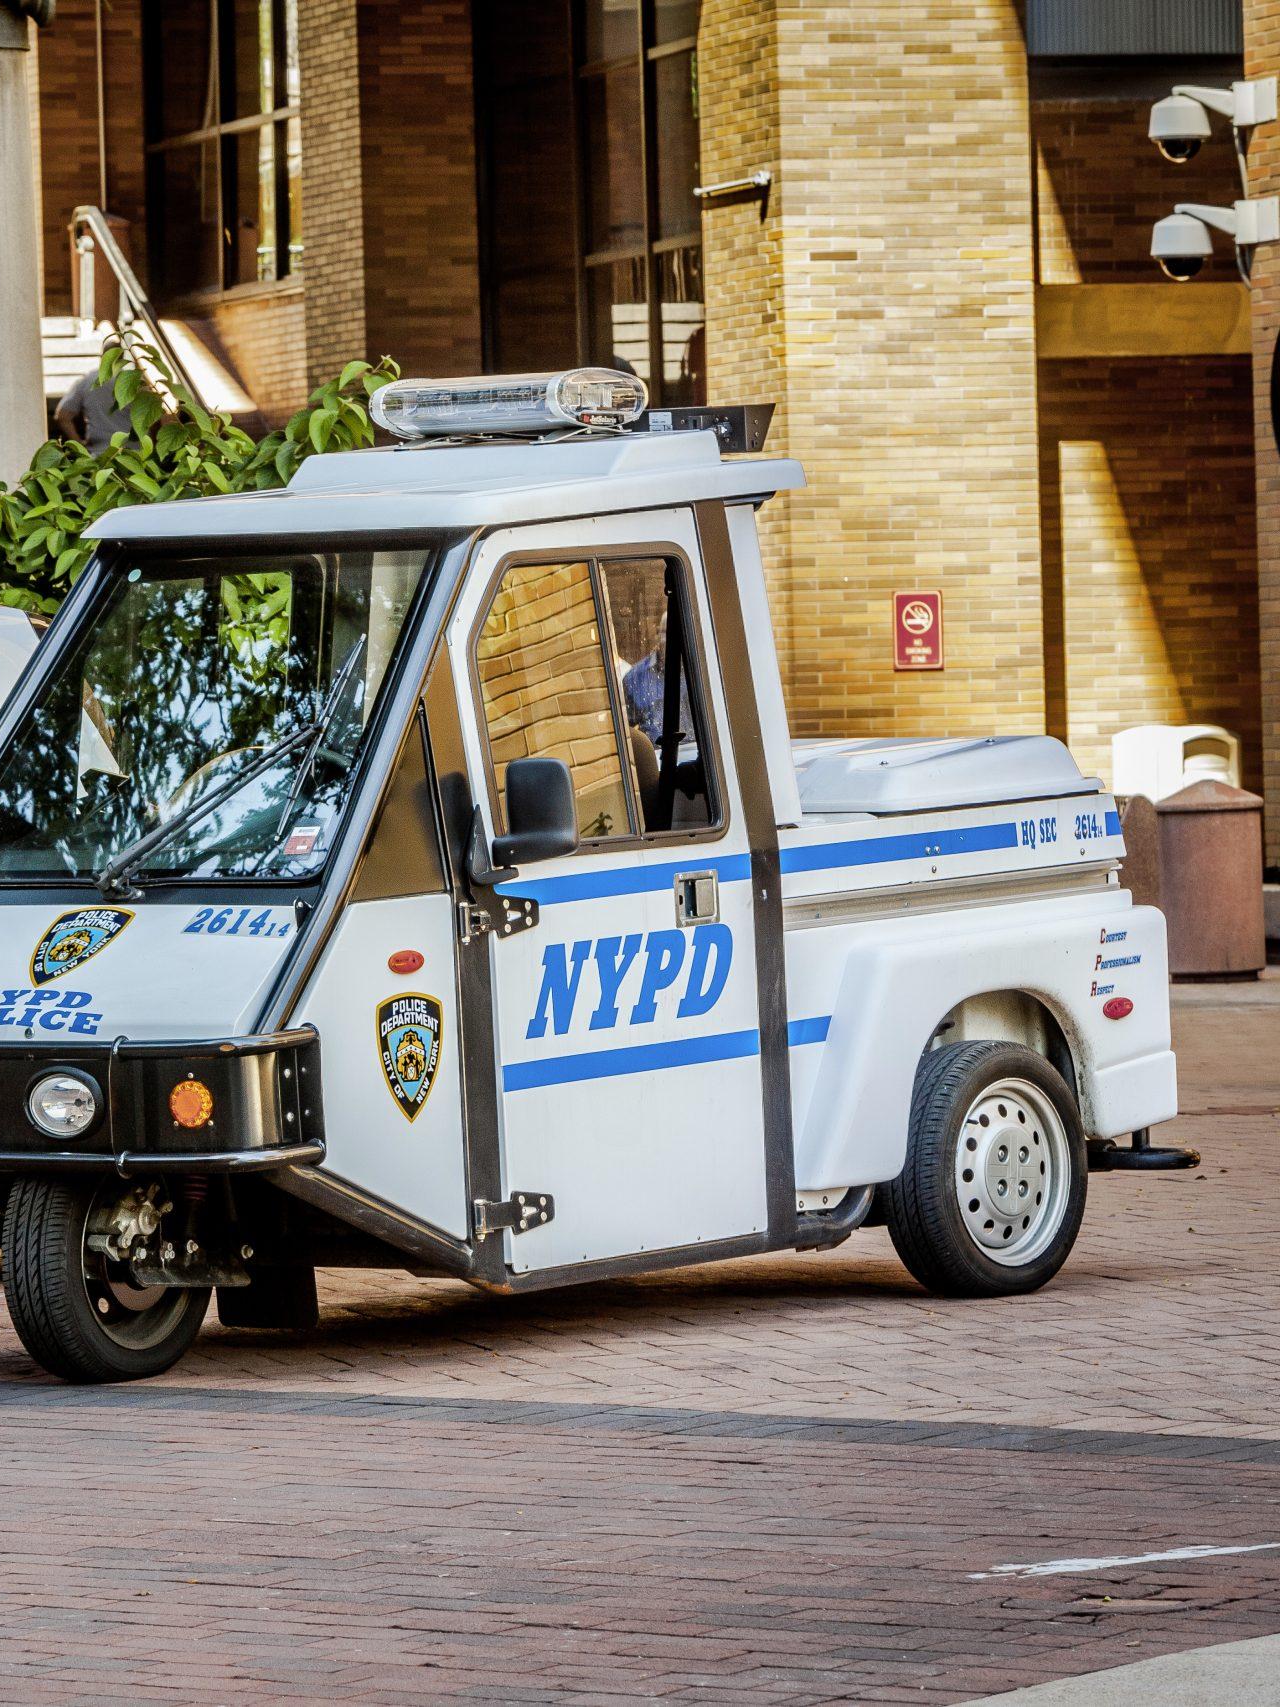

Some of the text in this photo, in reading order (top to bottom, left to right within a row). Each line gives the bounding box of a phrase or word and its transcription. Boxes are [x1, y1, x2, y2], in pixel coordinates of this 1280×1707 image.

[1021, 817, 1057, 850] HQ SEC
[50, 918, 122, 934] DEPARTMENT
[75, 910, 119, 921] POLICE
[35, 941, 50, 960] CITY
[53, 960, 78, 977] NEW
[81, 937, 111, 958] YORK
[525, 923, 734, 1040] NYPD
[392, 998, 427, 1016] POLICE
[380, 1011, 439, 1038] DEPARTMENT
[382, 1039, 440, 1104] CITY OF NEW YORK
